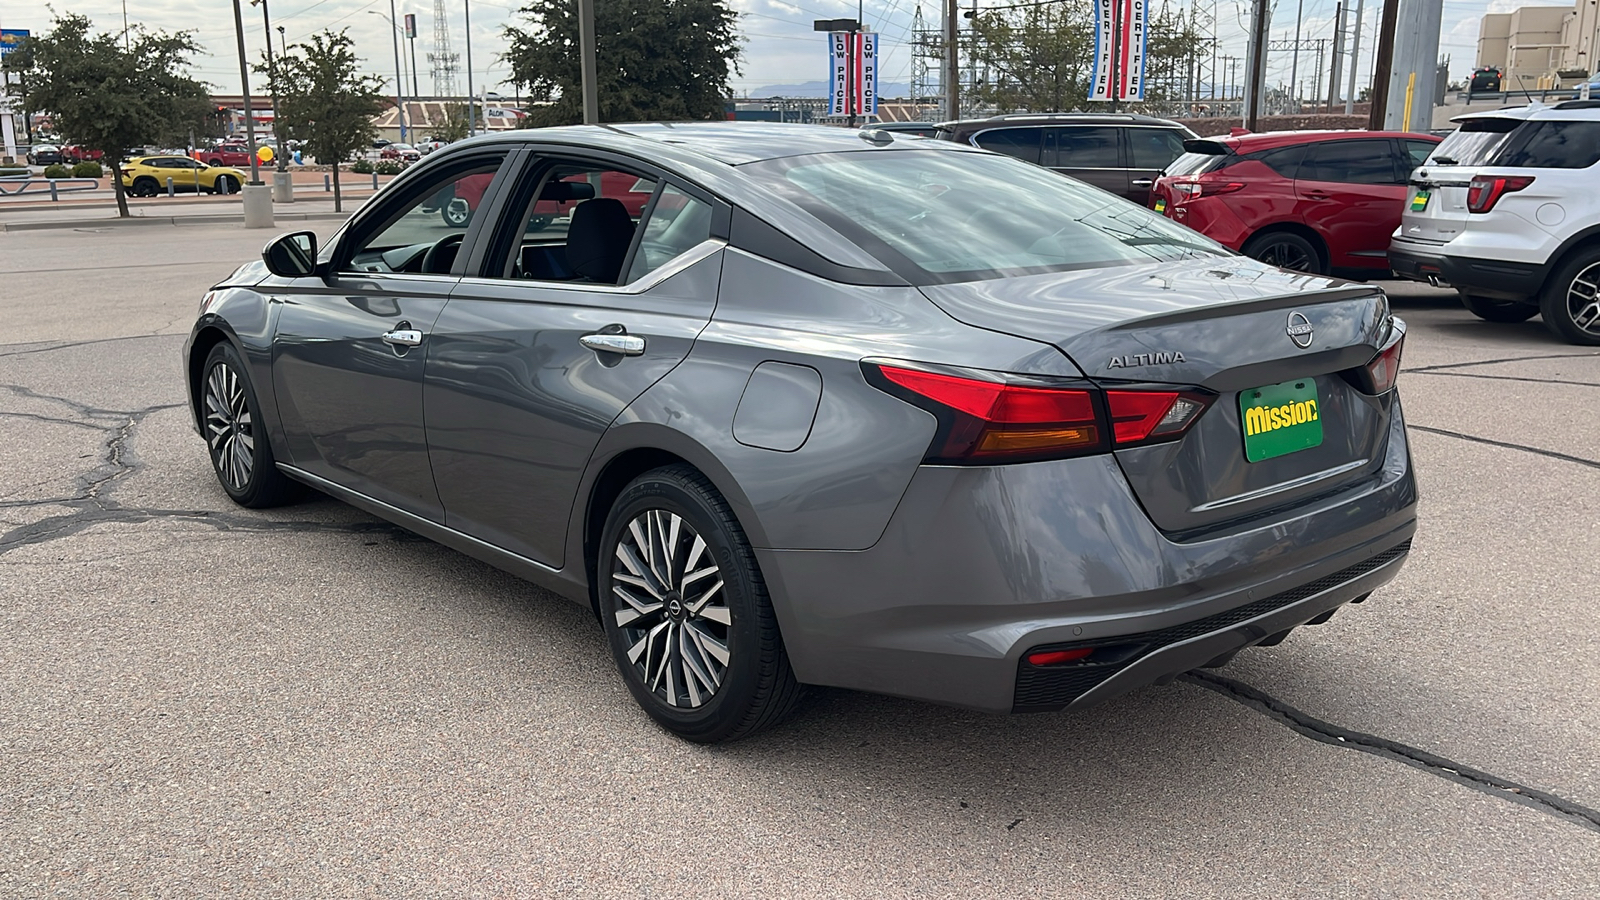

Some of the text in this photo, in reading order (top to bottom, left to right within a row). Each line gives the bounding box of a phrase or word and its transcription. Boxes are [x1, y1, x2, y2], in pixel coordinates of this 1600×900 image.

[835, 35, 845, 113] LOW PRICES
[863, 35, 873, 113] LOW PRICES
[1097, 0, 1110, 94] CERTIFIED
[1130, 1, 1142, 95] CERTIFIED
[1107, 351, 1187, 370] ALTIMA
[1245, 399, 1318, 436] Mission
